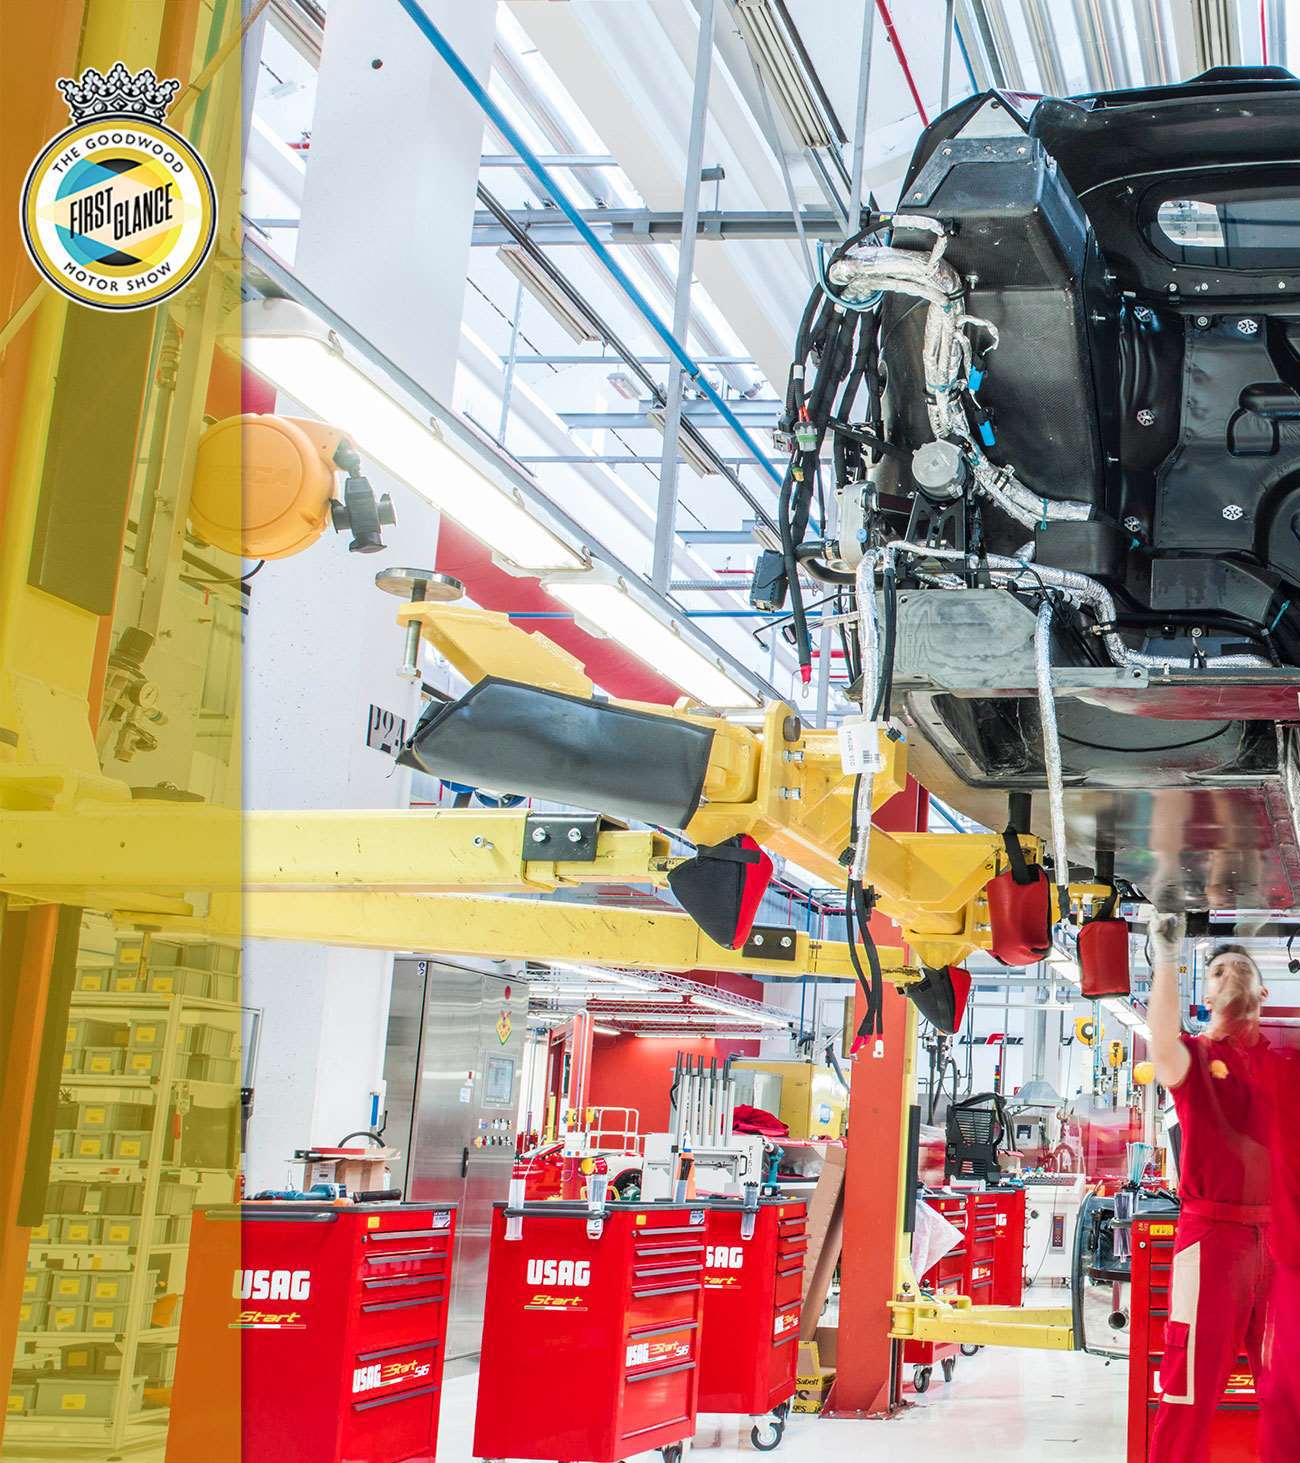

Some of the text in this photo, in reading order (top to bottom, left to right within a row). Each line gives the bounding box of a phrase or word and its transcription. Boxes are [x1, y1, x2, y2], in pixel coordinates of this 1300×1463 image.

[705, 1246, 744, 1269] SAG
[232, 1269, 311, 1300] USAG
[527, 1259, 591, 1286] USAG
[530, 1294, 583, 1306] Start
[237, 1311, 301, 1323] Start
[352, 1363, 382, 1393] USAG
[382, 1360, 418, 1377] Start
